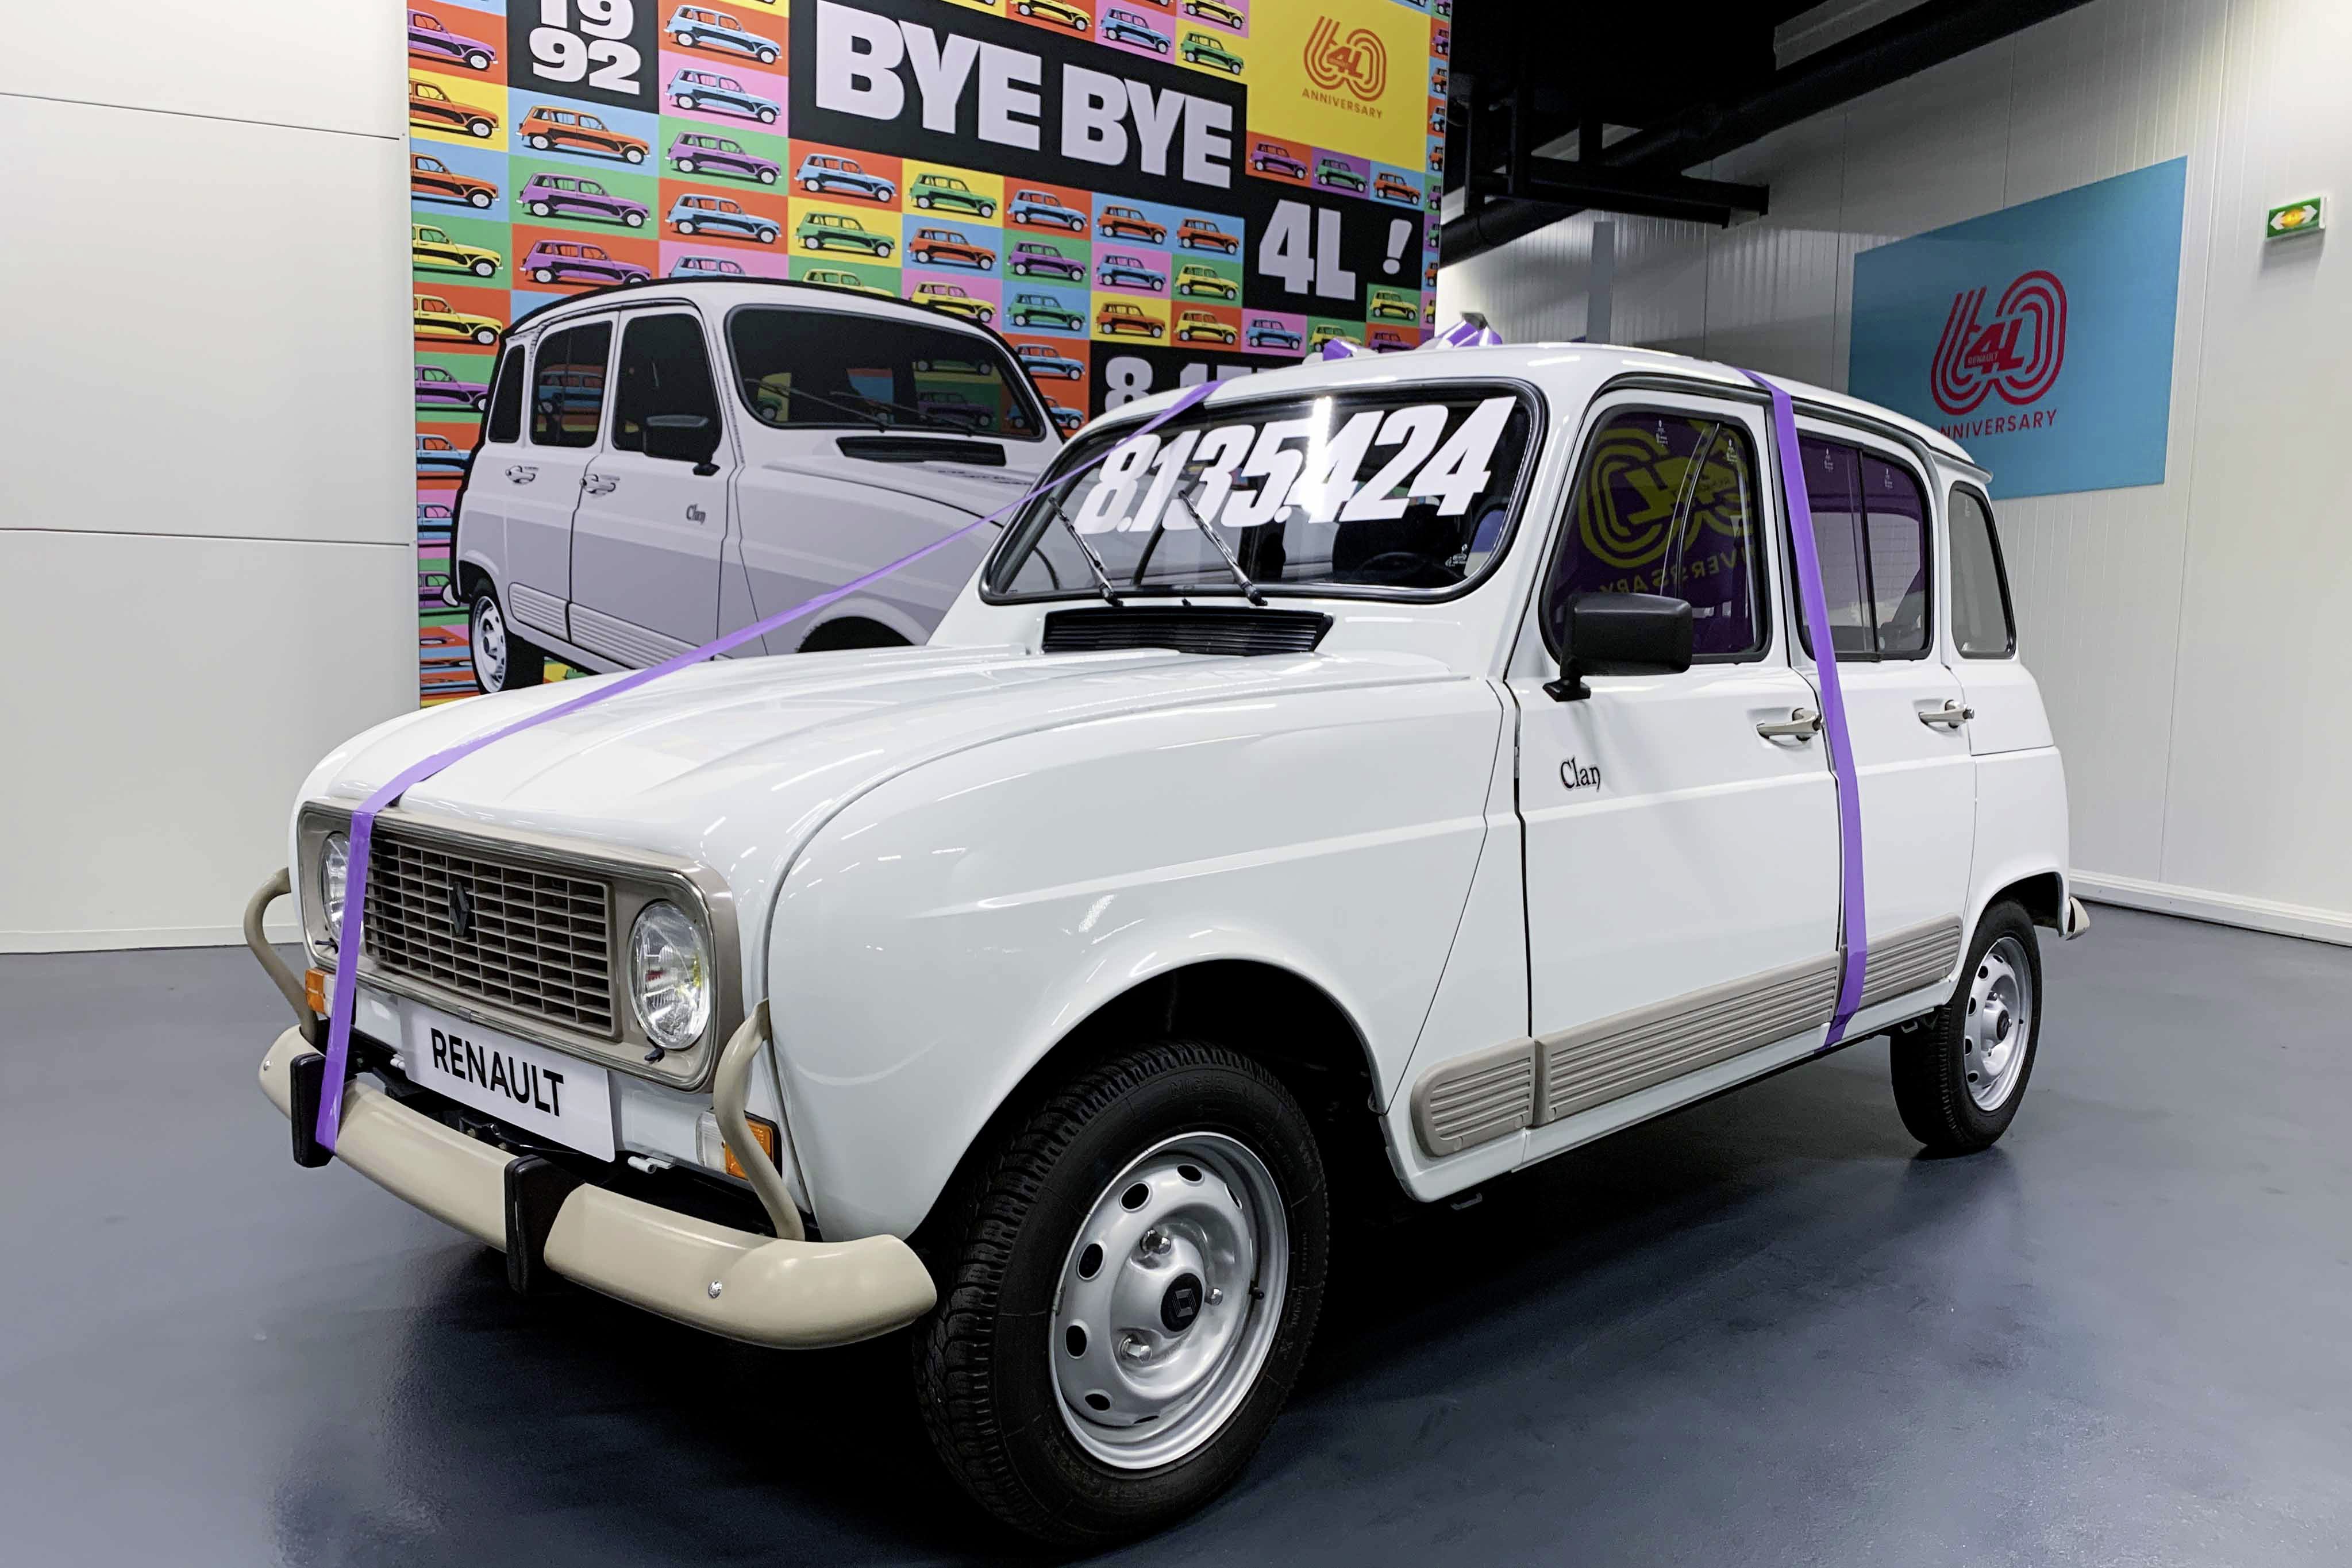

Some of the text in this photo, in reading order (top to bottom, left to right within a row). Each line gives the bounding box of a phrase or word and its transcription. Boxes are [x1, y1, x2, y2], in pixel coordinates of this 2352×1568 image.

[529, 27, 641, 95] 92
[816, 0, 1232, 188] BYE BYE
[1302, 87, 1382, 120] ANNIVERSARY
[1258, 199, 1356, 300] 4L
[1967, 351, 1999, 366] RENAULT
[1939, 409, 2057, 440] NNIVERSARY
[1074, 396, 1517, 535] 8.135.424
[1560, 756, 1600, 792] Clan
[430, 1027, 564, 1118] RENAULT
